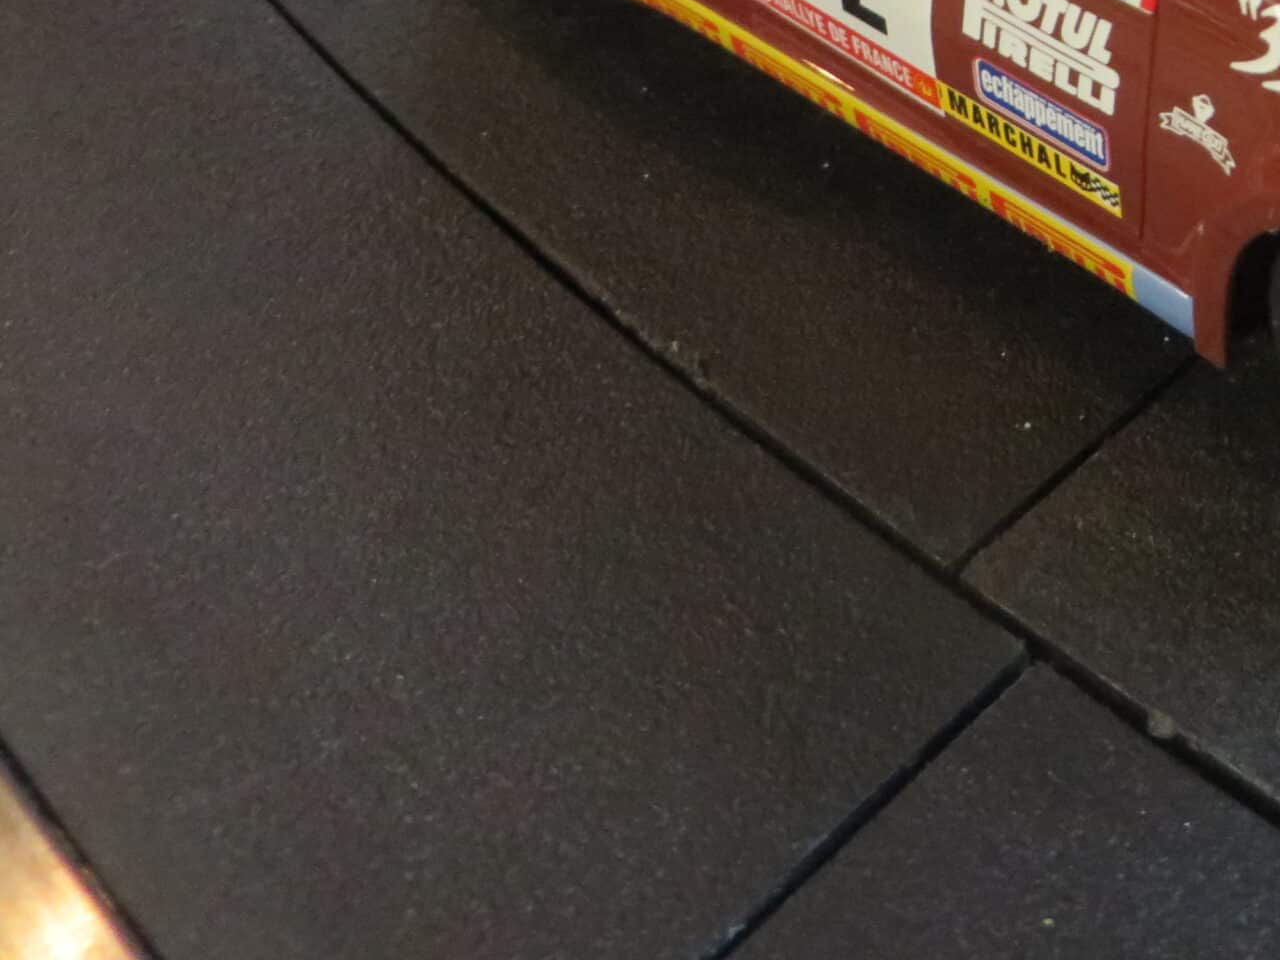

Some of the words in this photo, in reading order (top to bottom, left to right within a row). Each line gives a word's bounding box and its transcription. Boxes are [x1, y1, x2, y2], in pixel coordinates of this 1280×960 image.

[827, 19, 850, 50] DE
[850, 34, 914, 87] FRANCE
[946, 87, 1067, 179] MARCHAL
